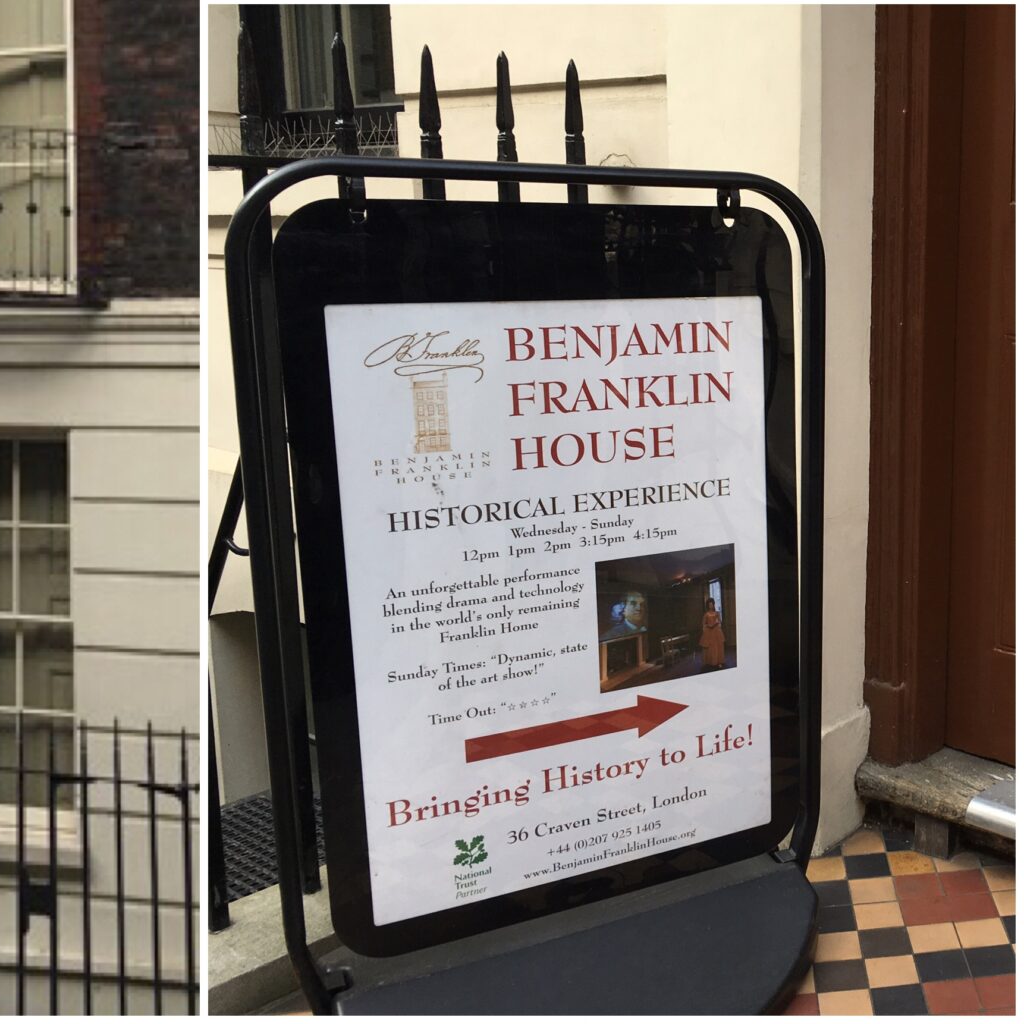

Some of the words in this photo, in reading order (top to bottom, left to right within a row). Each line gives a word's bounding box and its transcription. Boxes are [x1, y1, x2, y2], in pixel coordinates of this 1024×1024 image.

[504, 321, 733, 366] BENJAMIN
[508, 371, 733, 417] FRANKLIN
[374, 451, 490, 467] BENJAMIN
[510, 424, 676, 471] HOUSE
[375, 461, 491, 476] FRANKLIN
[396, 472, 472, 484] HOUSE
[387, 496, 565, 533] HISTORICAL
[573, 478, 731, 514] EXPERIENCE
[510, 521, 577, 539] Wednesday
[590, 514, 635, 530] Sunday
[462, 549, 500, 562] 12pm
[508, 545, 536, 558] 1pm
[543, 540, 572, 554] 2pm
[579, 533, 625, 548] 3:15pm
[633, 527, 677, 541] 4:15pm
[382, 601, 442, 618] blending
[446, 596, 487, 609] drama
[491, 588, 515, 602] and
[519, 581, 584, 598] technology
[385, 588, 406, 600] An
[411, 574, 499, 596] unforgettable
[504, 567, 581, 586] performance
[391, 623, 405, 634] in
[410, 617, 431, 630] the
[435, 610, 483, 627] world's
[486, 606, 514, 620] only
[518, 598, 580, 615] remaining
[440, 628, 496, 643] Franklin
[501, 622, 539, 634] Home
[387, 666, 438, 683] Sunday
[442, 660, 486, 674] Times:
[560, 643, 588, 655] state
[438, 678, 452, 692] of
[456, 675, 477, 688] the
[480, 674, 499, 684] art
[428, 712, 462, 725] Time
[466, 706, 496, 719] Out:
[385, 779, 531, 828] Bringing
[542, 757, 650, 793] History
[660, 746, 687, 765] to
[696, 723, 754, 758] Life!
[506, 828, 529, 845] 36
[535, 816, 591, 838] Craven
[596, 805, 647, 823] Street,
[652, 786, 708, 810] London
[523, 828, 697, 880] www.BenjaminFranklinHouse.org
[547, 843, 570, 857] +44
[574, 833, 608, 851] (0)207
[611, 827, 632, 841] 925
[636, 820, 662, 834] 1405
[454, 866, 492, 882] National
[455, 880, 478, 890] Trust
[455, 886, 488, 900] Partner
